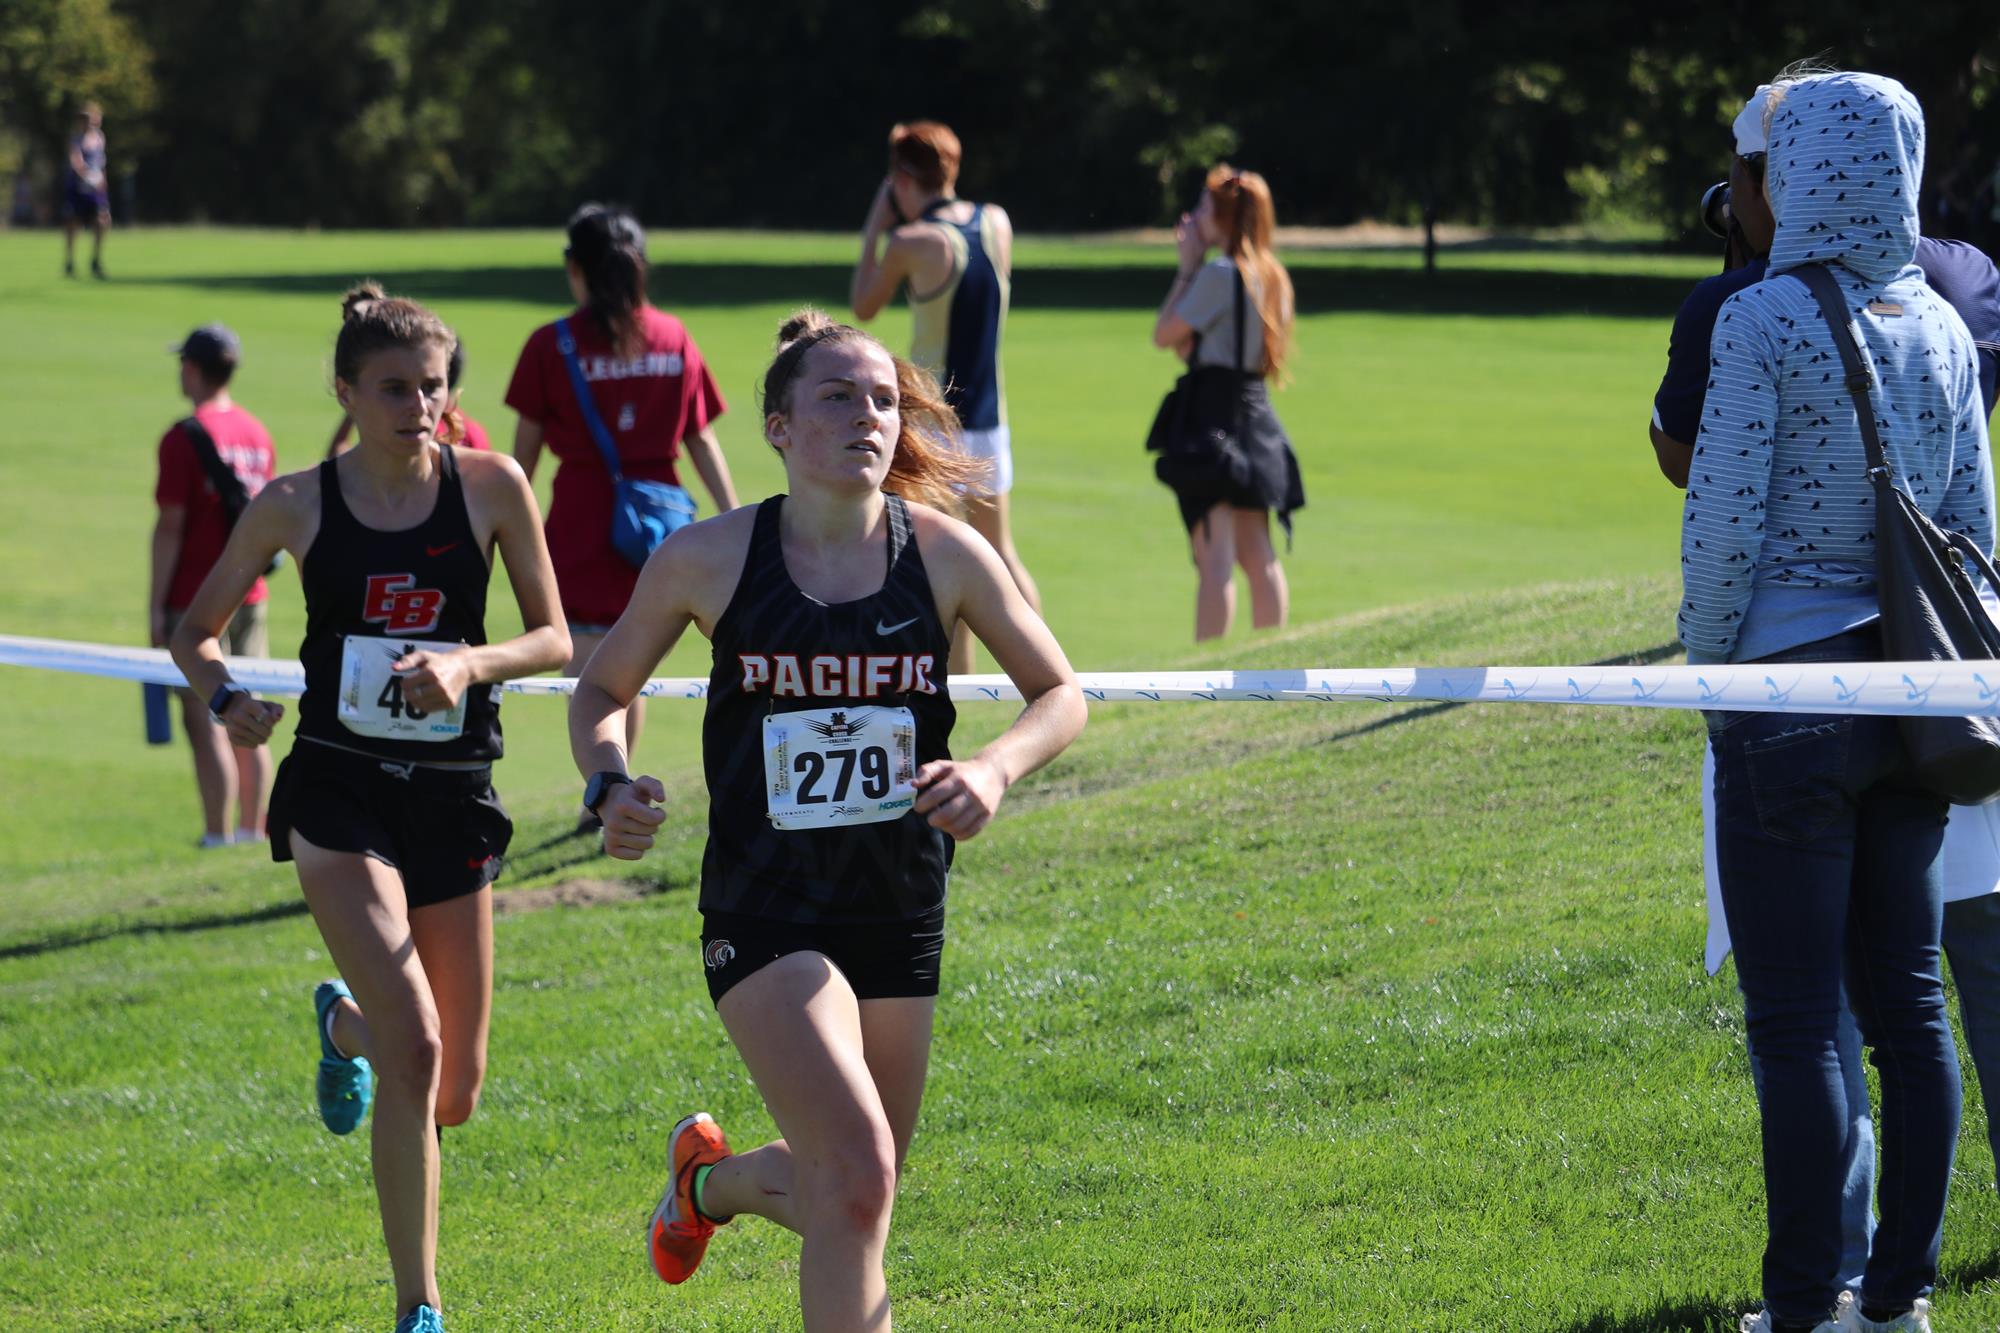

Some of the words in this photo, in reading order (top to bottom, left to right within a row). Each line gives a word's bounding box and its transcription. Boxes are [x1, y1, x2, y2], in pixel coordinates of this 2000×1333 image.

[362, 572, 447, 635] EB
[738, 653, 938, 697] PACIFIC
[793, 746, 891, 805] 279
